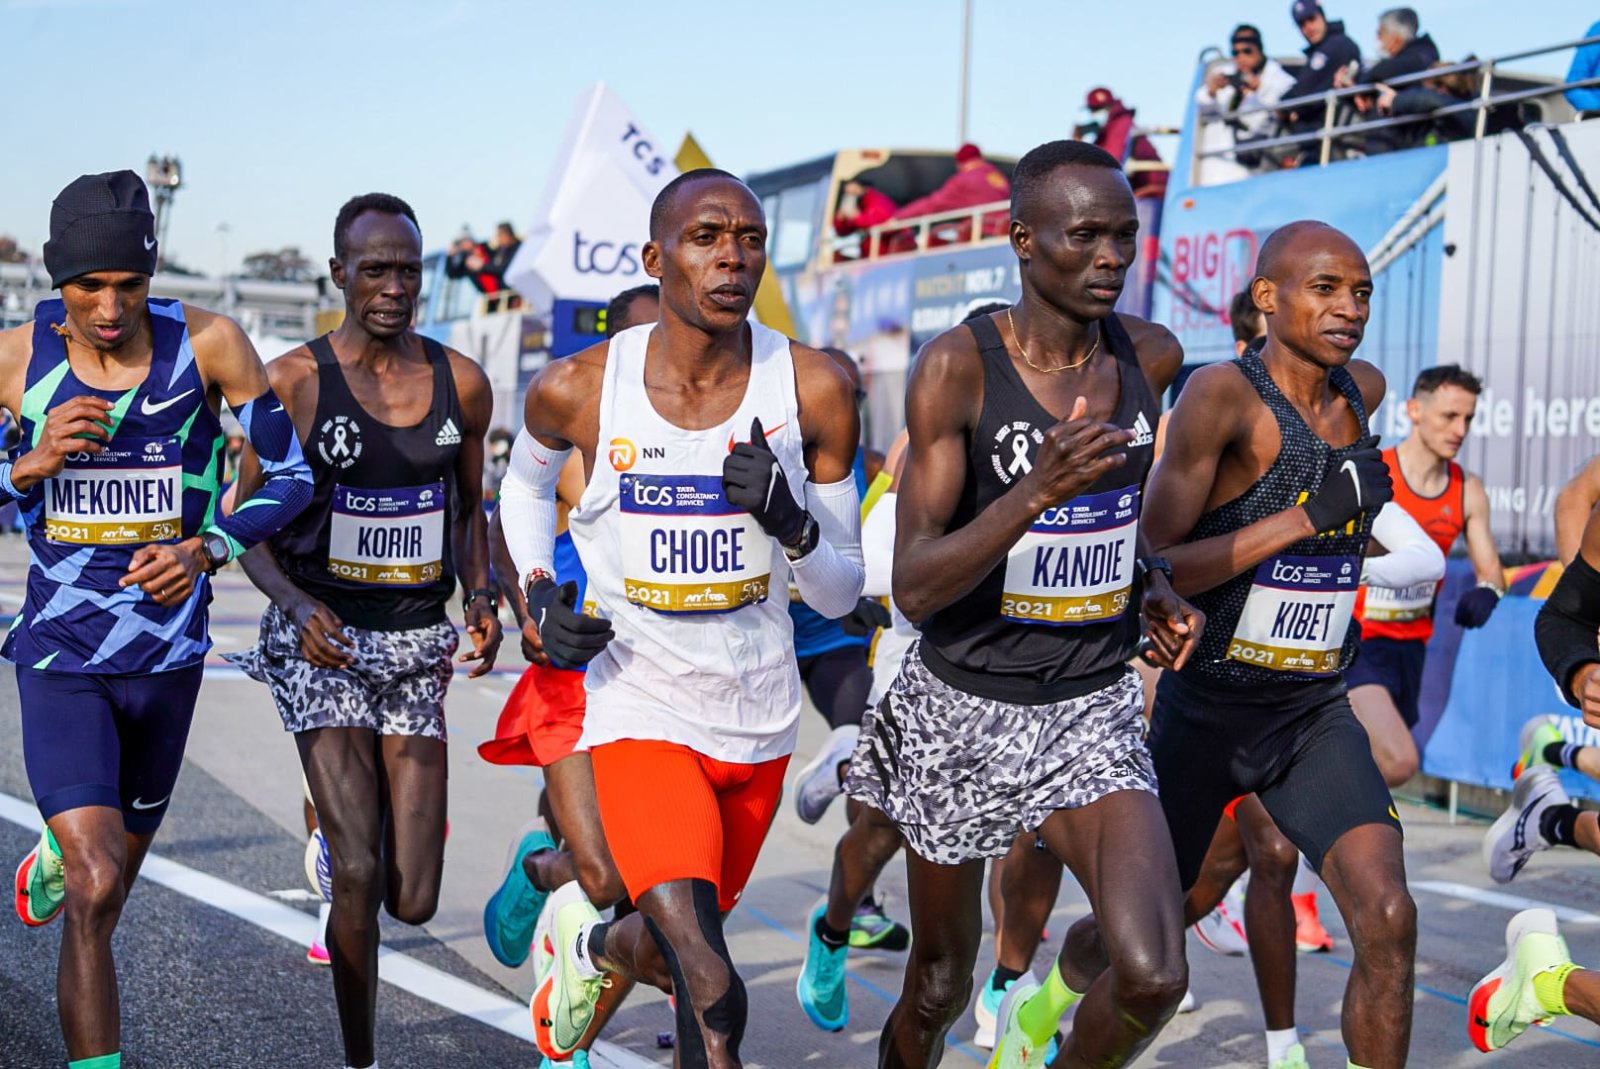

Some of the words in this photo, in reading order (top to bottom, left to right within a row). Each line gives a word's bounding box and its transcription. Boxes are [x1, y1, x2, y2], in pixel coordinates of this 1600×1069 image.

[620, 122, 666, 176] TCS
[573, 230, 639, 276] tcs
[1173, 232, 1219, 284] BIG
[142, 454, 166, 462] TATA
[642, 447, 665, 459] NN
[52, 478, 174, 515] MEKONEN
[346, 491, 376, 512] tcs
[634, 480, 673, 506] tcs
[416, 500, 434, 509] TATA
[1114, 508, 1132, 519] TATA
[48, 525, 89, 539] 2021
[357, 525, 422, 559] KORIR
[650, 528, 745, 574] CHOGE
[331, 563, 368, 579] 2021
[1032, 539, 1125, 588] KANDIE
[1272, 559, 1304, 583] tcs
[627, 585, 670, 605] 2021
[1003, 600, 1053, 616] 2021
[1270, 602, 1335, 642] KIBET
[1230, 644, 1275, 664] 2021
